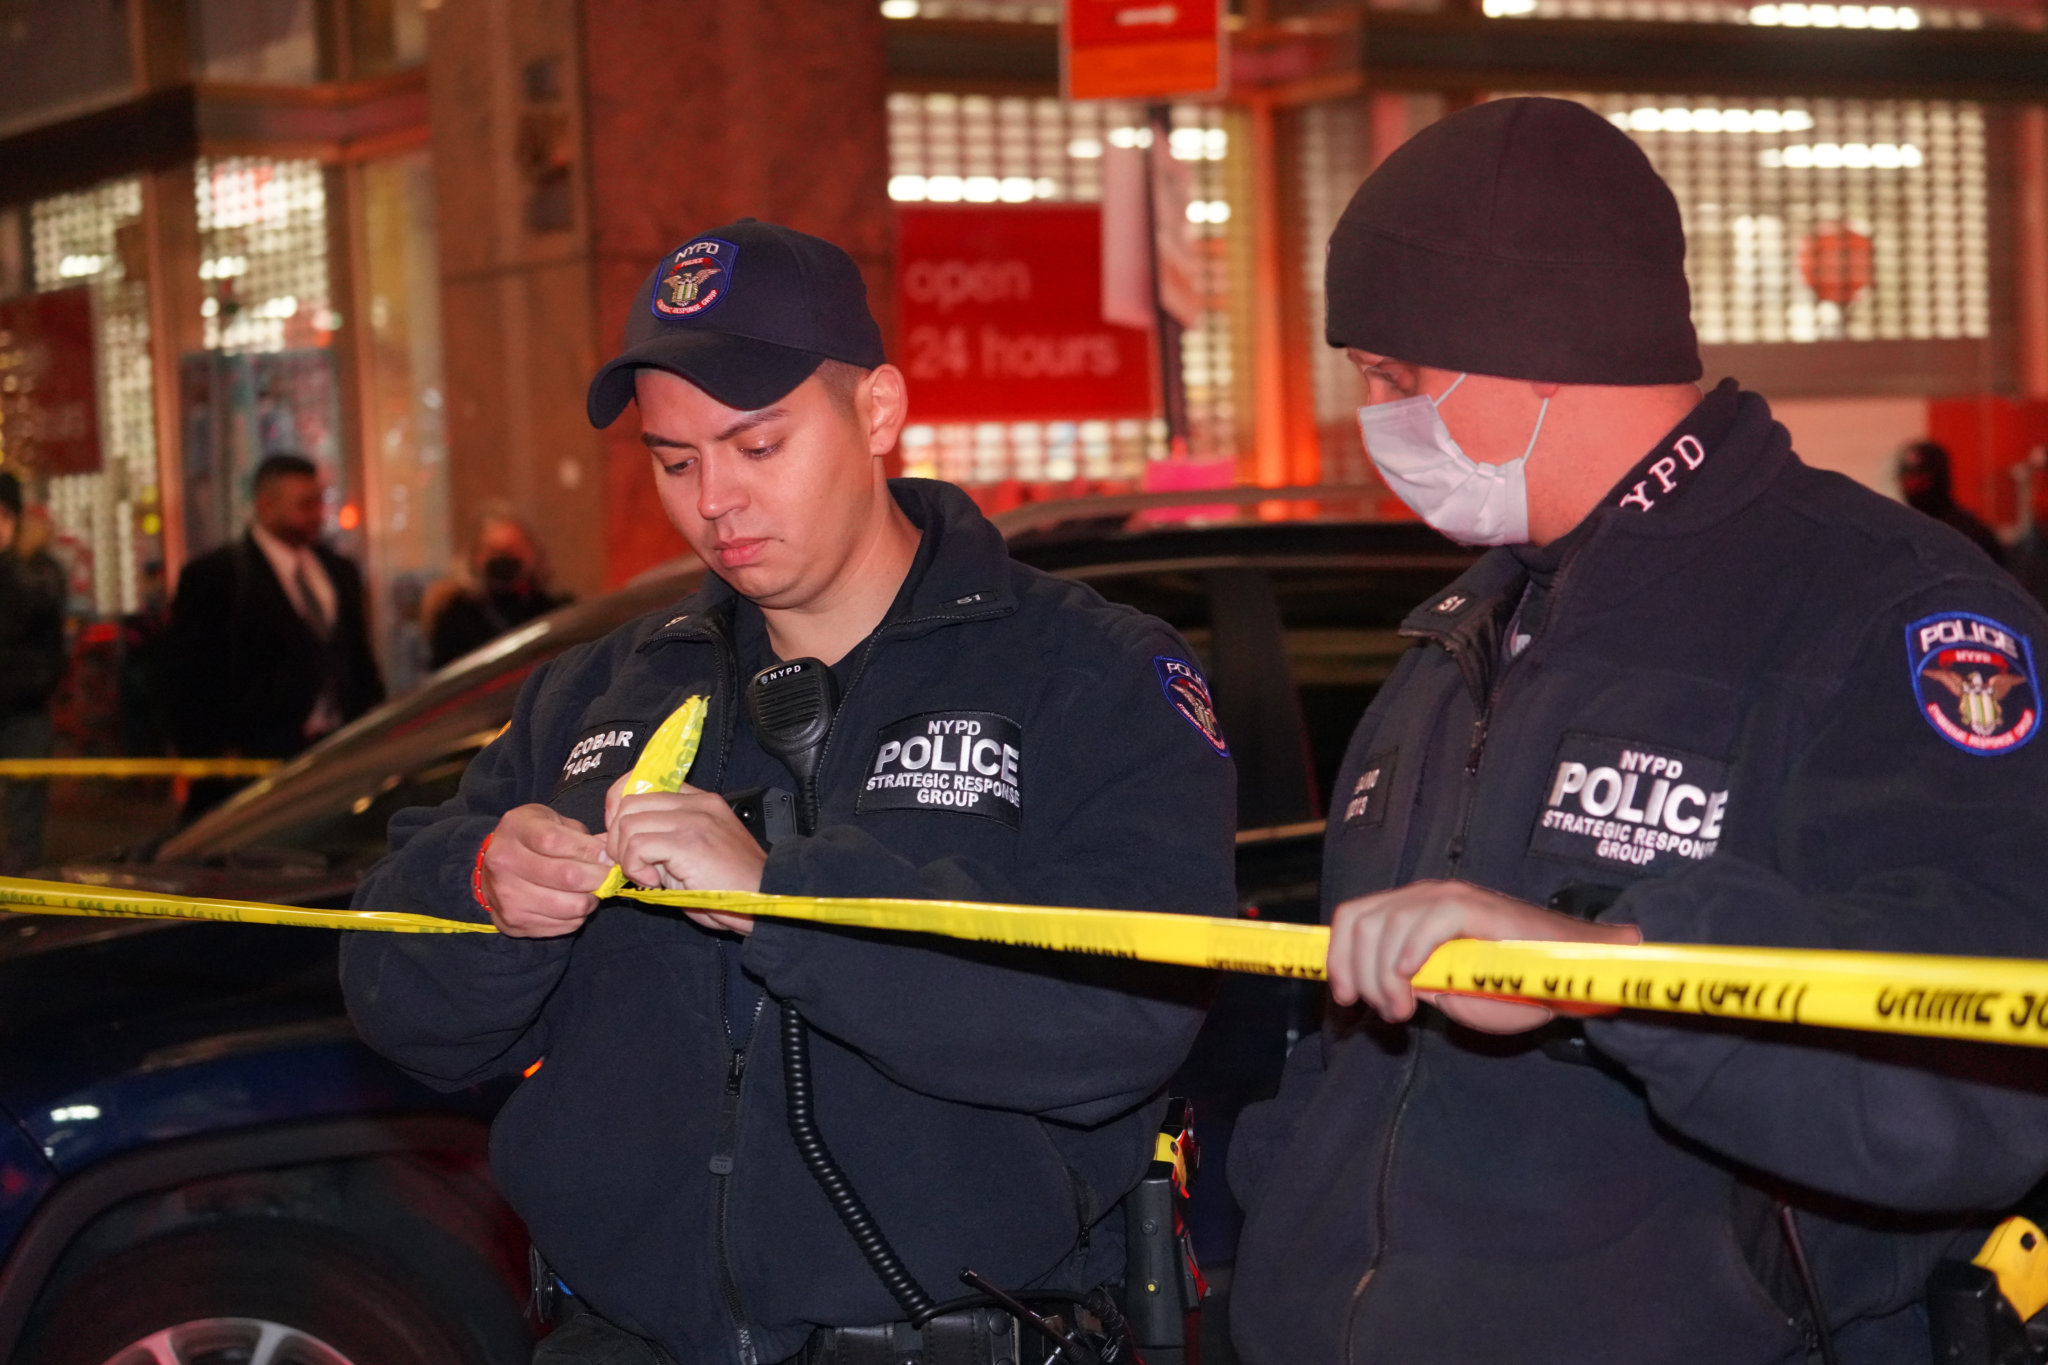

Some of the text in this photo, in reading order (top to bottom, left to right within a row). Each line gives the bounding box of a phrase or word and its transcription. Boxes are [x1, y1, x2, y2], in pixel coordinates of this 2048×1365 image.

[674, 242, 720, 263] NYPD
[904, 260, 1032, 314] open
[908, 325, 1121, 380] 24 hours
[1619, 434, 1705, 512] YPD
[1919, 619, 2019, 660] POLICE
[770, 664, 802, 681] NYPD
[928, 720, 981, 736] NYPD
[873, 735, 1020, 787] POLICE
[1619, 749, 1683, 780] NYPD
[866, 772, 1020, 808] STRATEGIC RESPONSE
[916, 788, 979, 807] GROUP
[1548, 761, 1729, 840] POLICE
[1541, 809, 1632, 842] STRATEGIC
[1596, 839, 1655, 866] GROUP
